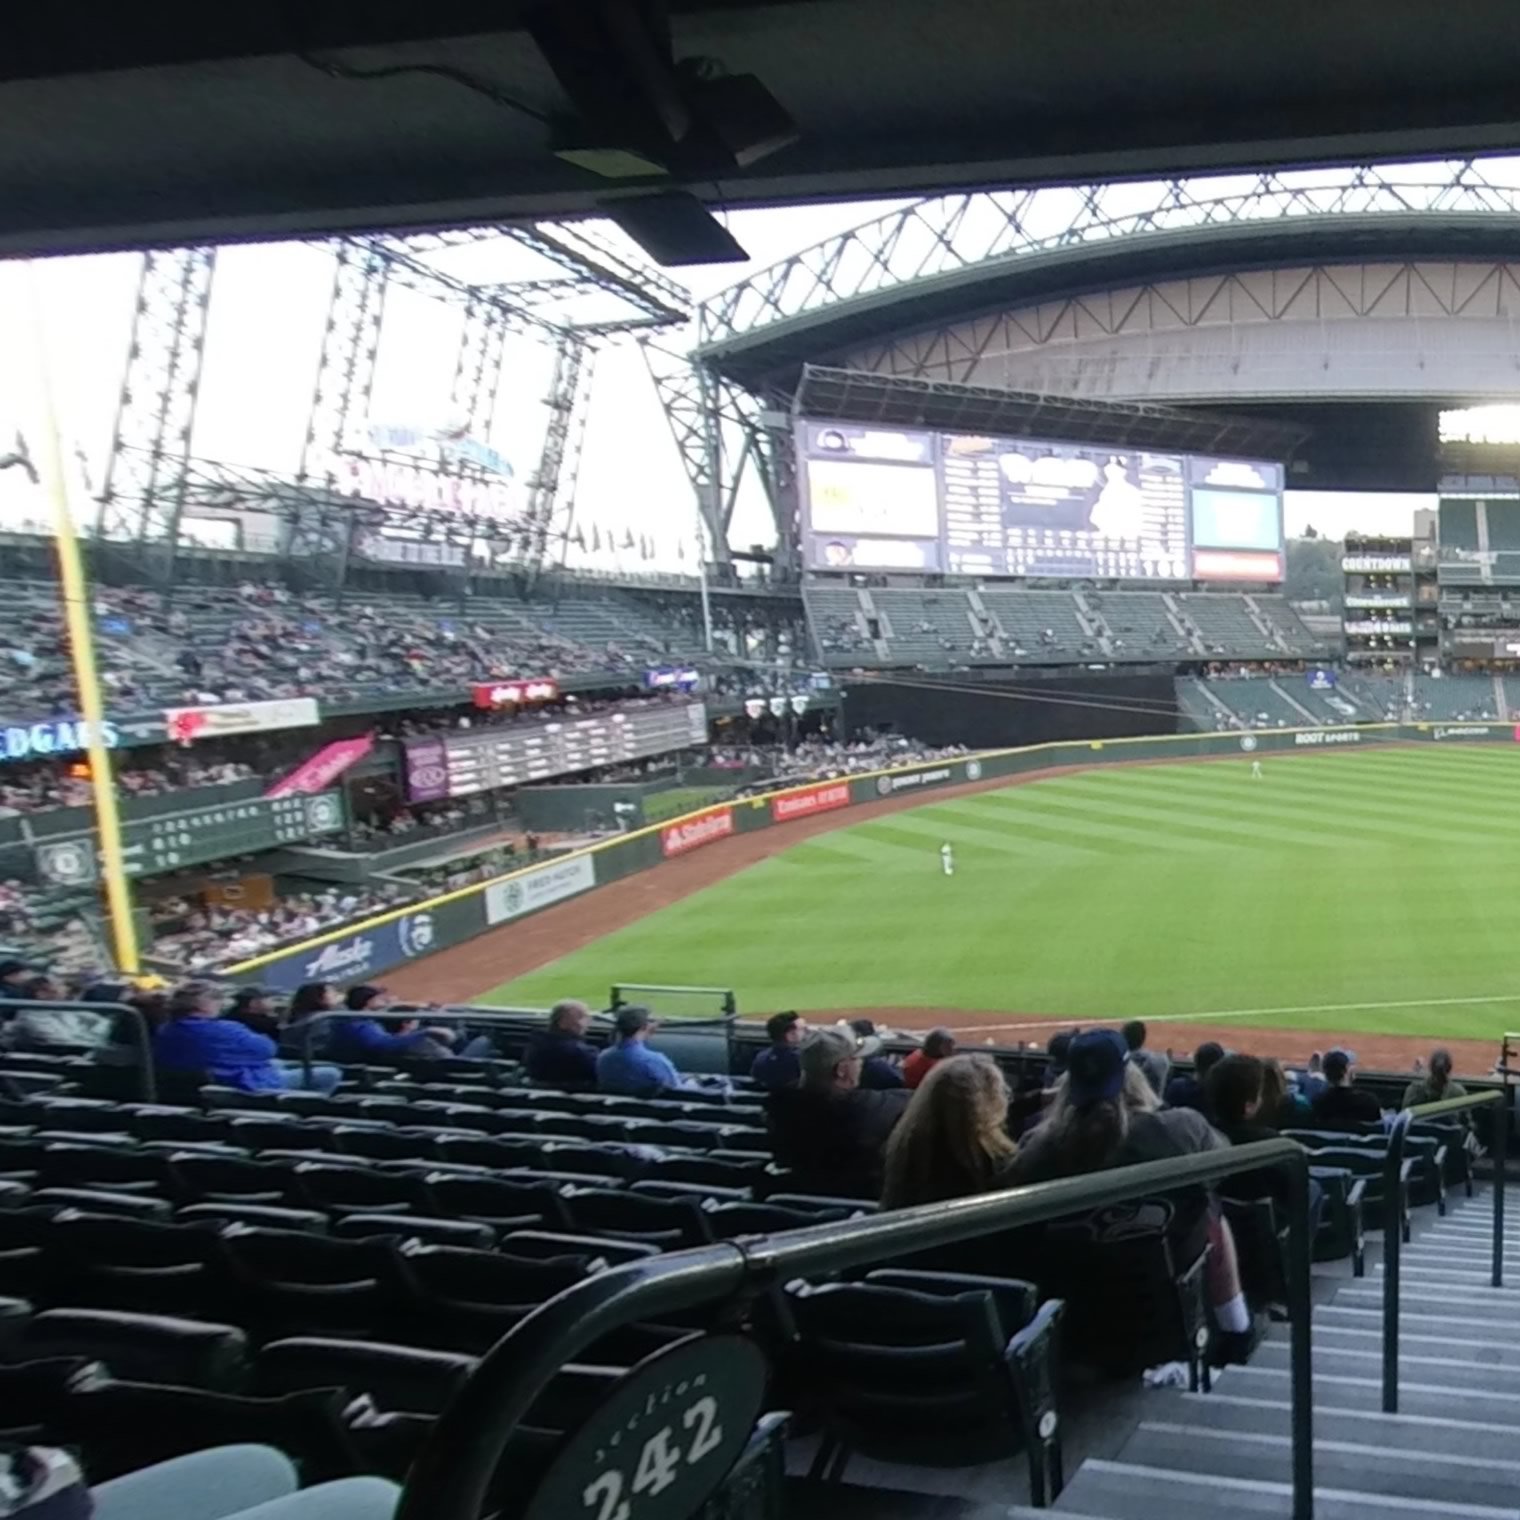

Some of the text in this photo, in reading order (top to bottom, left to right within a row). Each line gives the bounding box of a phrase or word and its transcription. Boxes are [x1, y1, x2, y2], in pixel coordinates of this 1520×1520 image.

[1342, 556, 1410, 571] COUNTDOWN
[1295, 732, 1324, 744] ROOT
[583, 1396, 722, 1520] 242
